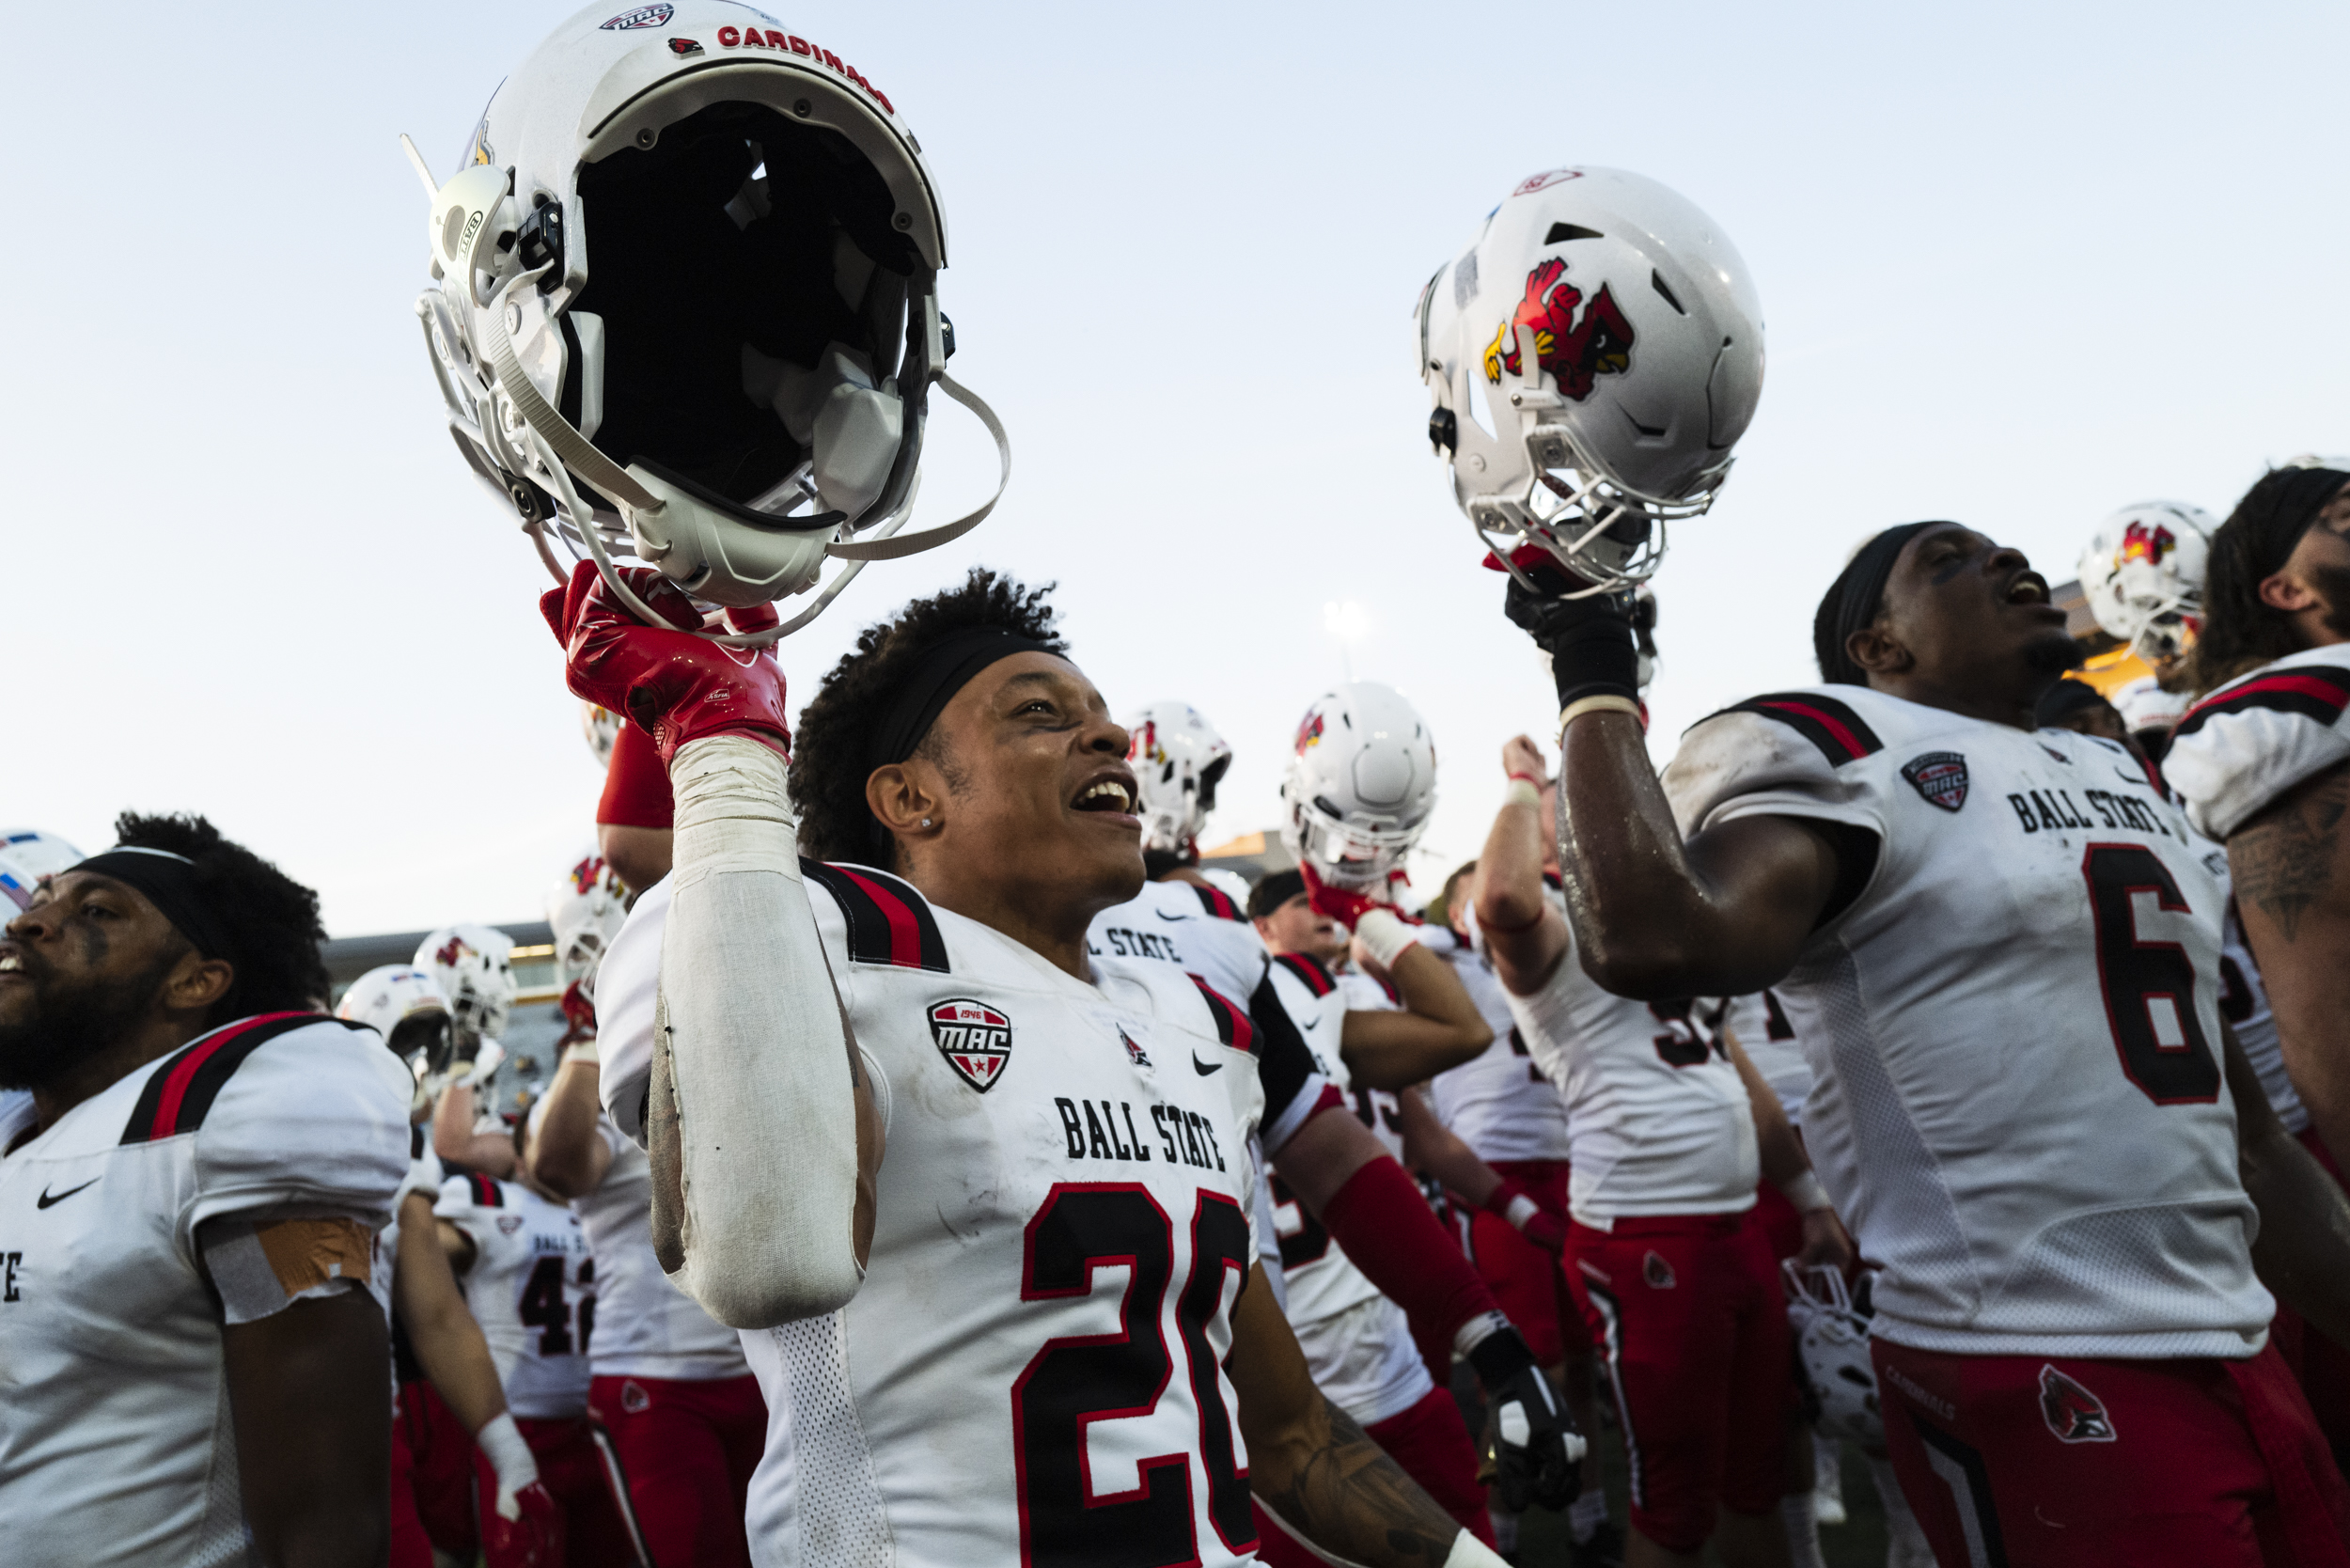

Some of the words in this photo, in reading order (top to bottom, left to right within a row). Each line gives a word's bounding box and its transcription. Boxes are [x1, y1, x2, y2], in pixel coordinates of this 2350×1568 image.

[2007, 789, 2094, 834] BALL
[1106, 928, 1183, 963] STATE
[2081, 842, 2221, 1106] 6
[961, 1010, 982, 1019] 1946
[938, 1026, 1011, 1051] MAC
[1054, 1097, 1151, 1162] BALL
[1151, 1105, 1226, 1173] STATE
[1011, 1182, 1261, 1568] 20
